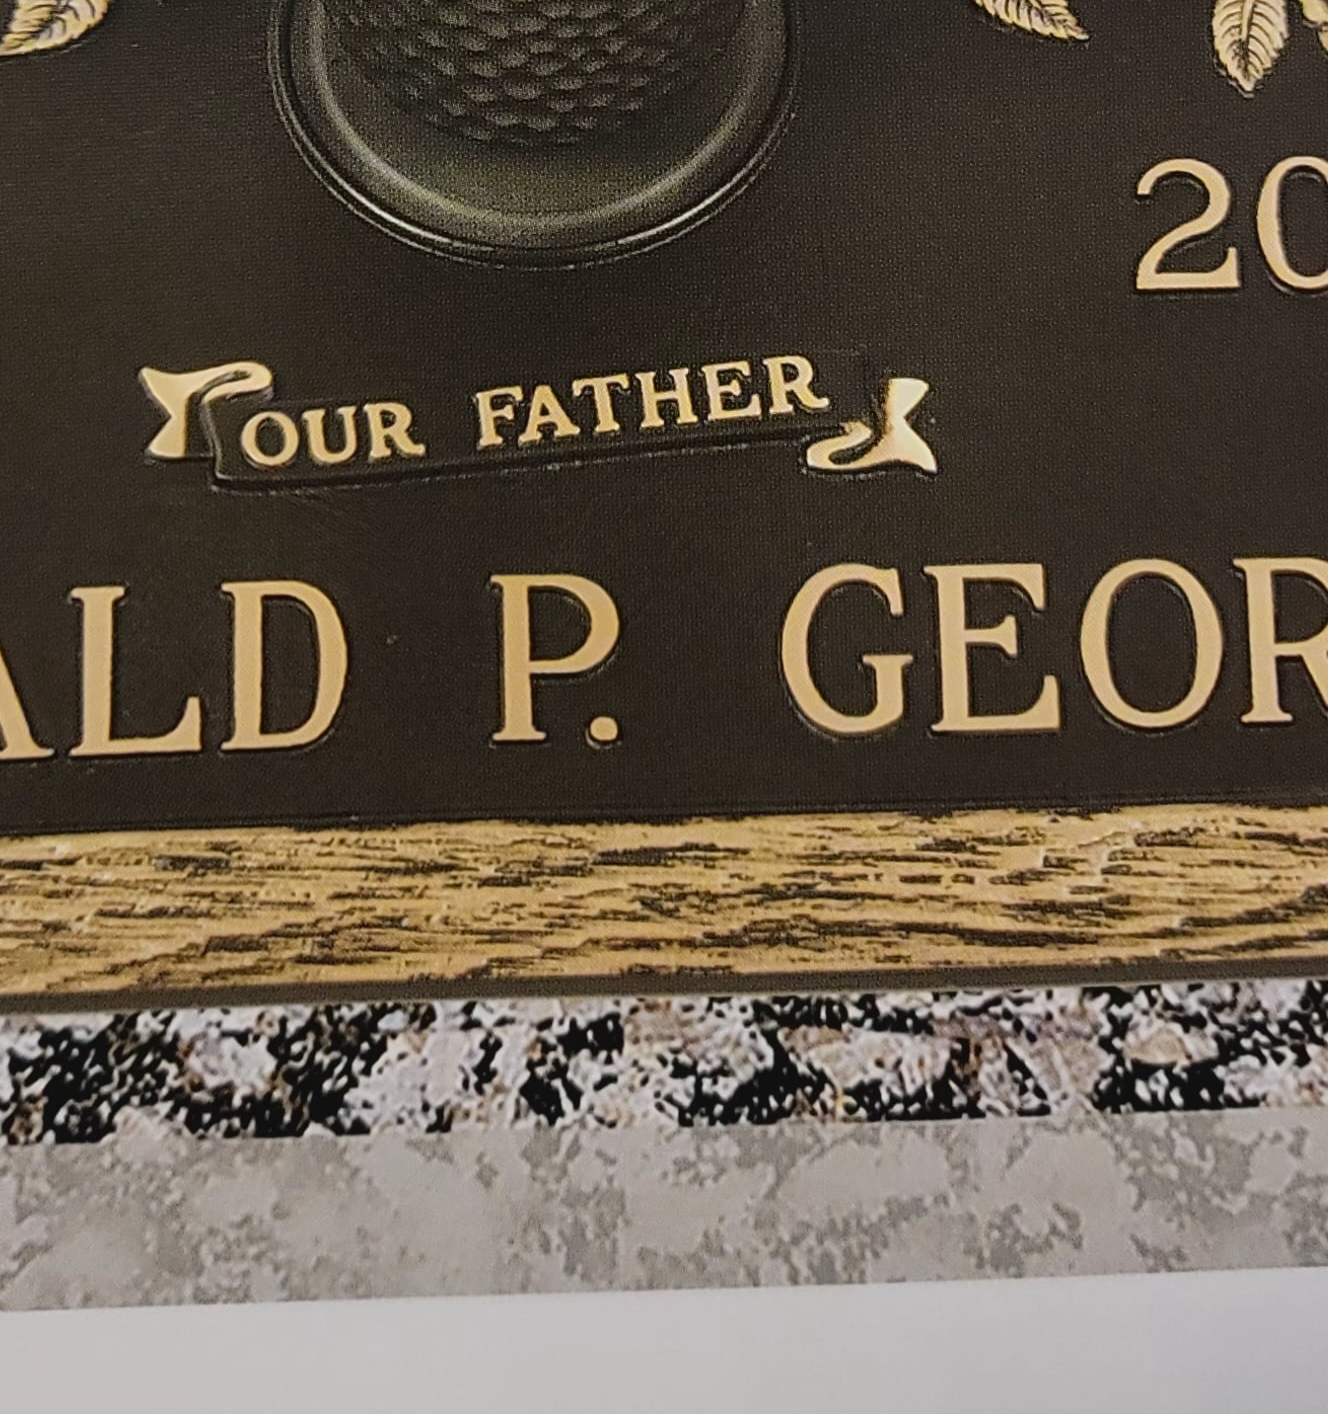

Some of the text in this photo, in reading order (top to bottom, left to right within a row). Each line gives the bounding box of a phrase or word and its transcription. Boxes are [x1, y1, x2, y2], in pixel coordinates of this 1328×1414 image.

[239, 355, 829, 468] OUR FATHER
[491, 575, 618, 740] P.
